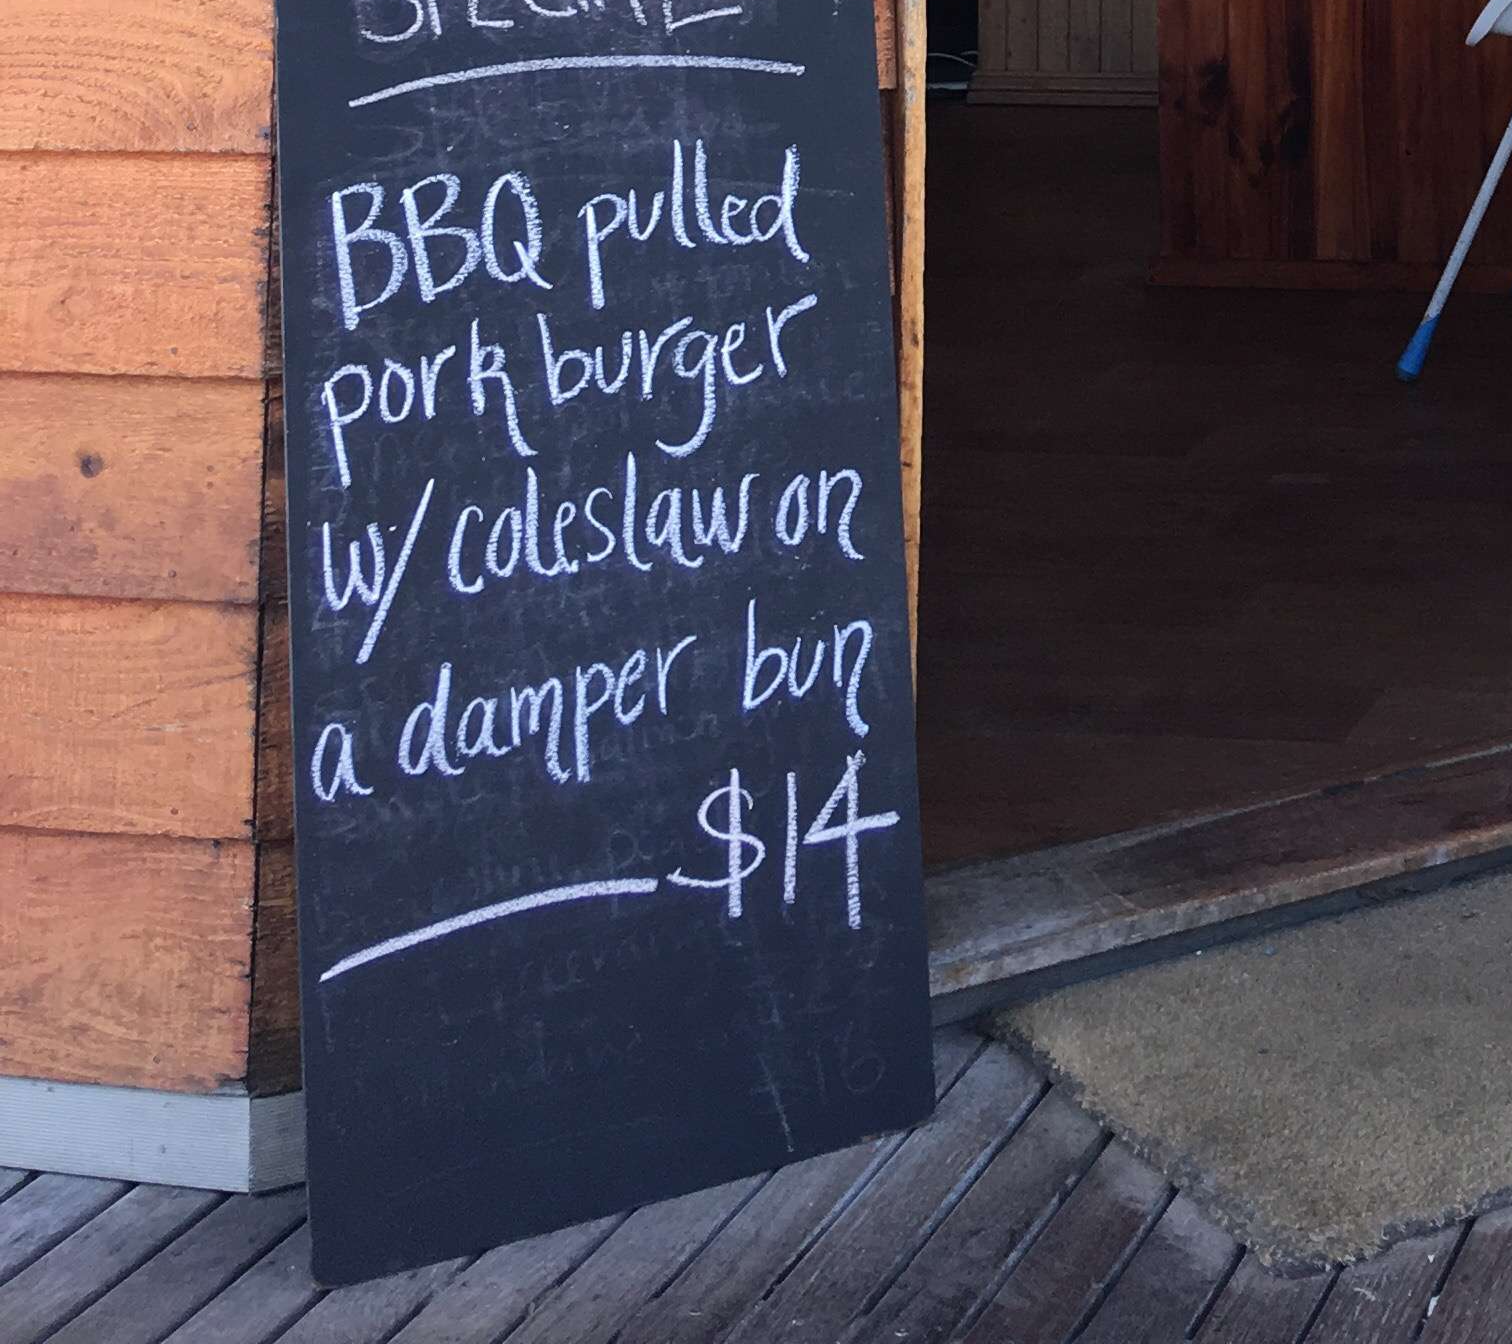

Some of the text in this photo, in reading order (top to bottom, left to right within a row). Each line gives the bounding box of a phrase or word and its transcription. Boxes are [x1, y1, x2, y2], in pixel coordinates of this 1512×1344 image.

[330, 138, 811, 331] BBQ pulled
[322, 294, 819, 489] pork burger
[322, 451, 867, 666] w/ coleslaw on
[309, 598, 877, 804] a damper bun
[666, 749, 901, 931] $14
